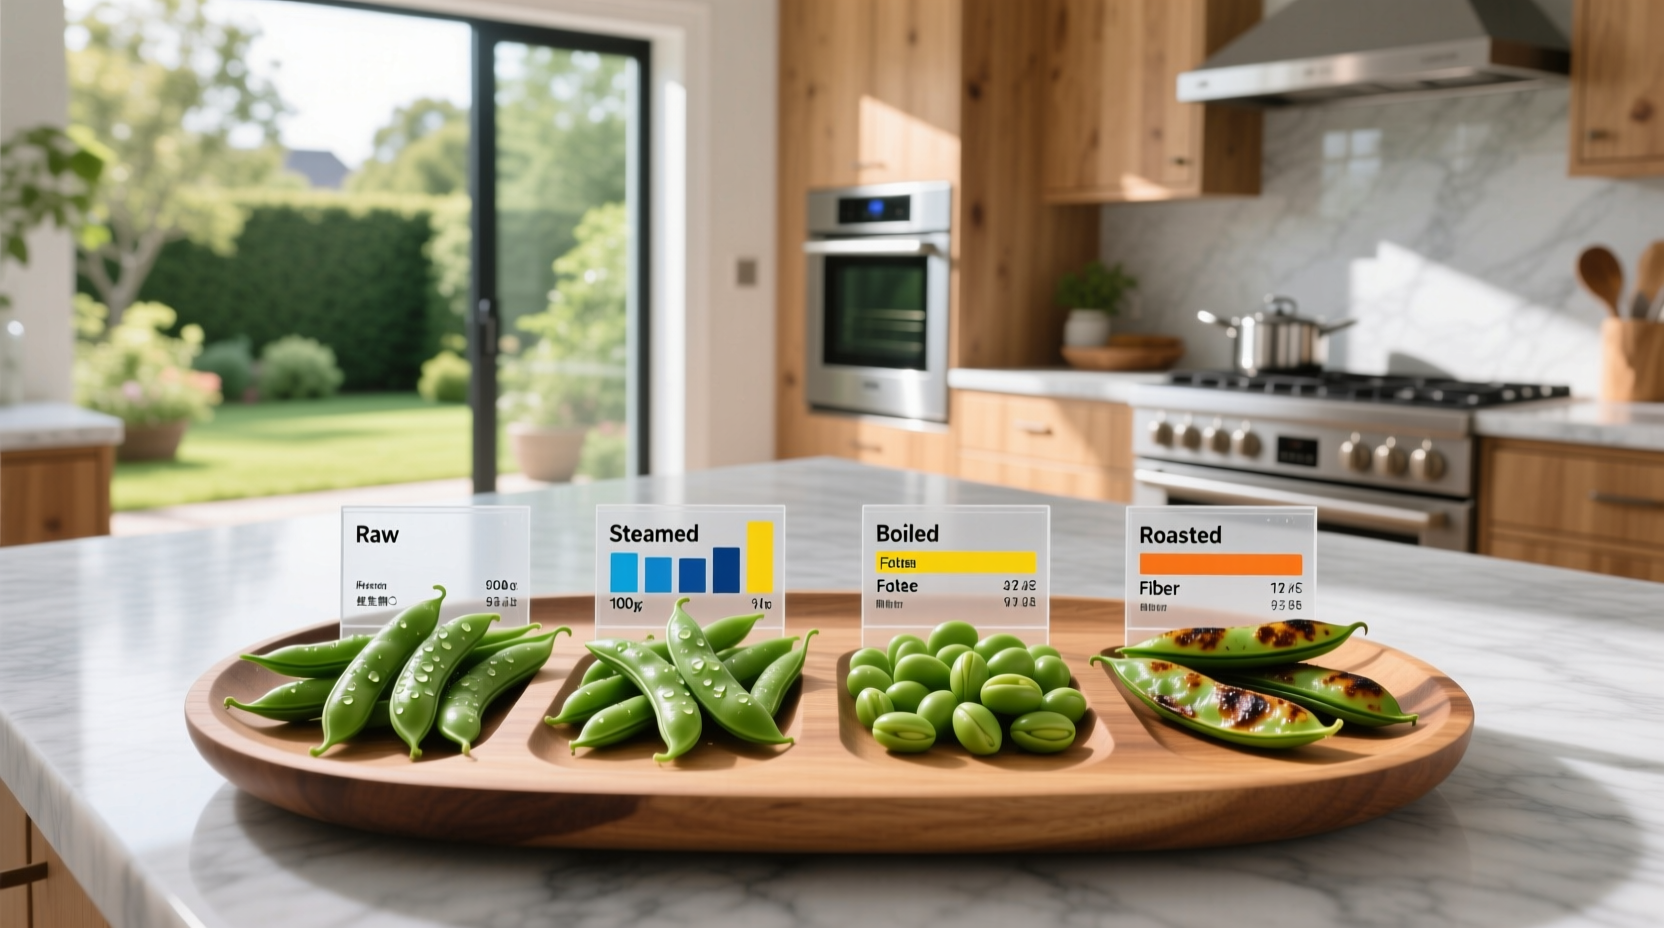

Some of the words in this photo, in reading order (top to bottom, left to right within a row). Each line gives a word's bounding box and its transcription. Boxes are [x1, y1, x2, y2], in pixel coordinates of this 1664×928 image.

[356, 524, 400, 543] Raw
[609, 523, 699, 543] Steamed
[876, 522, 940, 543] Boiled
[1140, 525, 1222, 544] Roasted
[1139, 579, 1181, 596] Fiber
